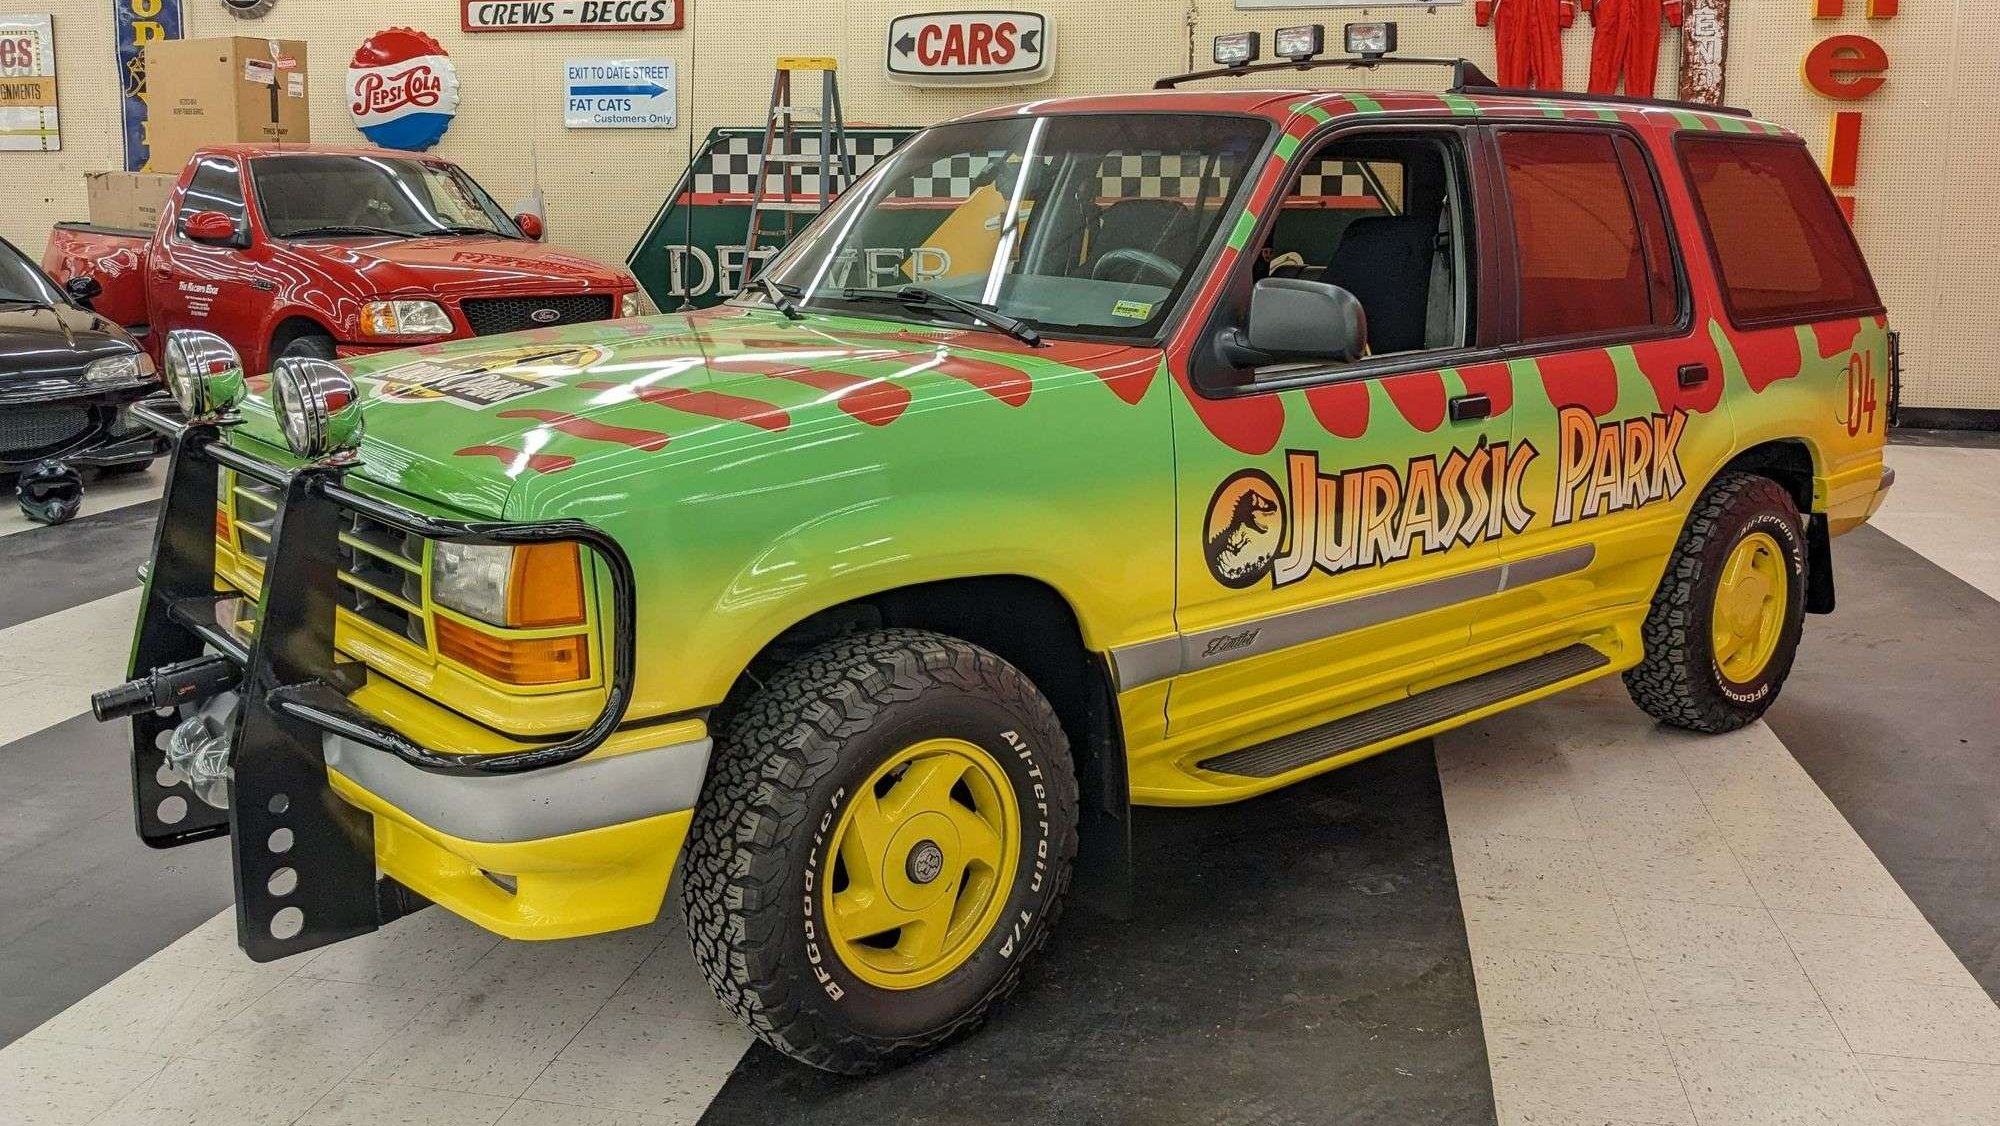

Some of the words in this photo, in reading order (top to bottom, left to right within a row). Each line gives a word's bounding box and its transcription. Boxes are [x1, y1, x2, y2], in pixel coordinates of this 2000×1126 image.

[478, 3, 554, 25] CREWS
[580, 0, 666, 24] BEGGS
[917, 22, 1017, 67] CARS
[569, 67, 589, 79] EXIT
[591, 67, 604, 79] TO
[606, 66, 631, 79] DATE
[633, 66, 669, 79] STREET
[569, 98, 593, 111] FAT
[597, 98, 632, 112] CATS
[594, 114, 646, 123] Customers
[649, 114, 672, 125] Only
[664, 244, 951, 297] DEVER
[1847, 349, 1877, 437] 04
[1272, 436, 1540, 588] JURASSIC
[1553, 403, 1689, 526] PARK
[1739, 514, 1794, 542] All-Terrain
[1202, 627, 1262, 657] Limited
[1000, 730, 1050, 892] All-Terrain
[804, 786, 848, 1001] BFGoodrich
[999, 909, 1033, 959] T/A
